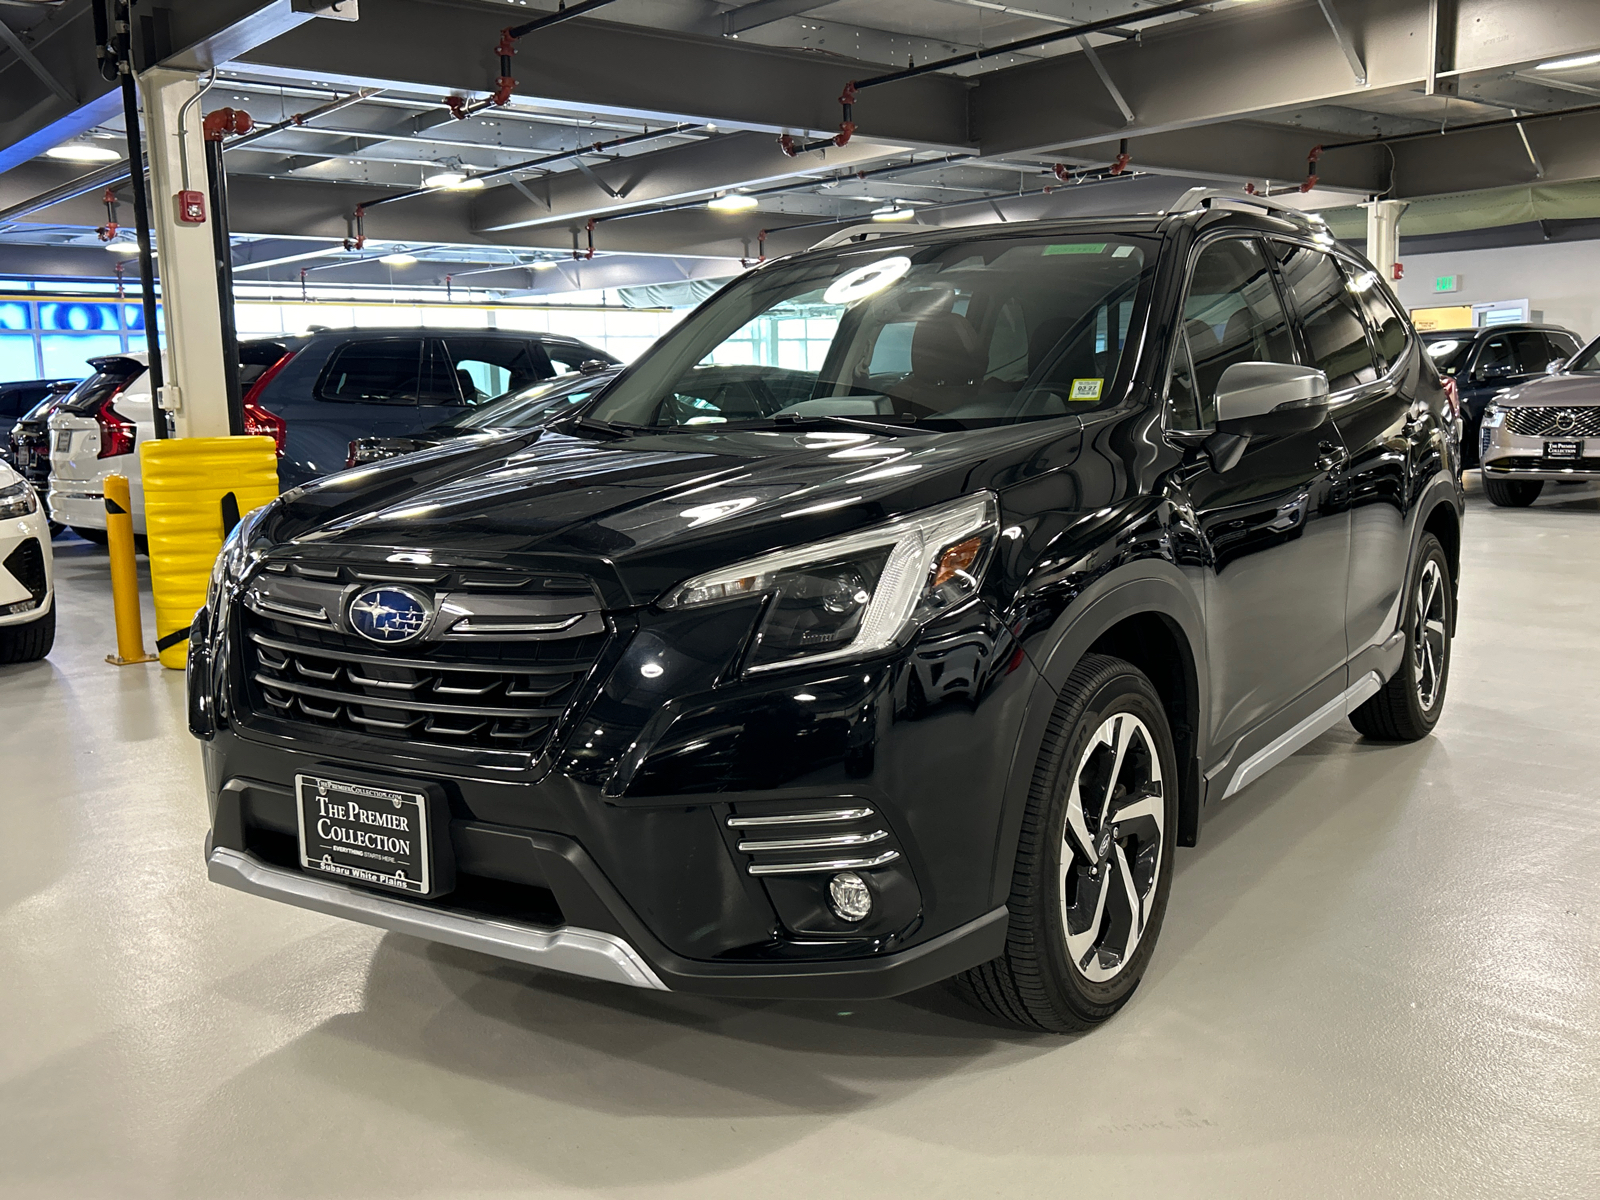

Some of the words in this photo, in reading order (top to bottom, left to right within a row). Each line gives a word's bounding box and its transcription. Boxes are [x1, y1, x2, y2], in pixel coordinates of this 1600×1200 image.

[1436, 276, 1453, 291] EXIT
[315, 796, 347, 820] THE
[347, 801, 410, 832] PREMIER
[317, 818, 410, 856] COLLECTION
[332, 845, 364, 857] EVERYTHING
[364, 851, 382, 861] STARTS
[320, 862, 350, 875] Subaru
[351, 869, 378, 881] White
[380, 875, 408, 888] Plains
